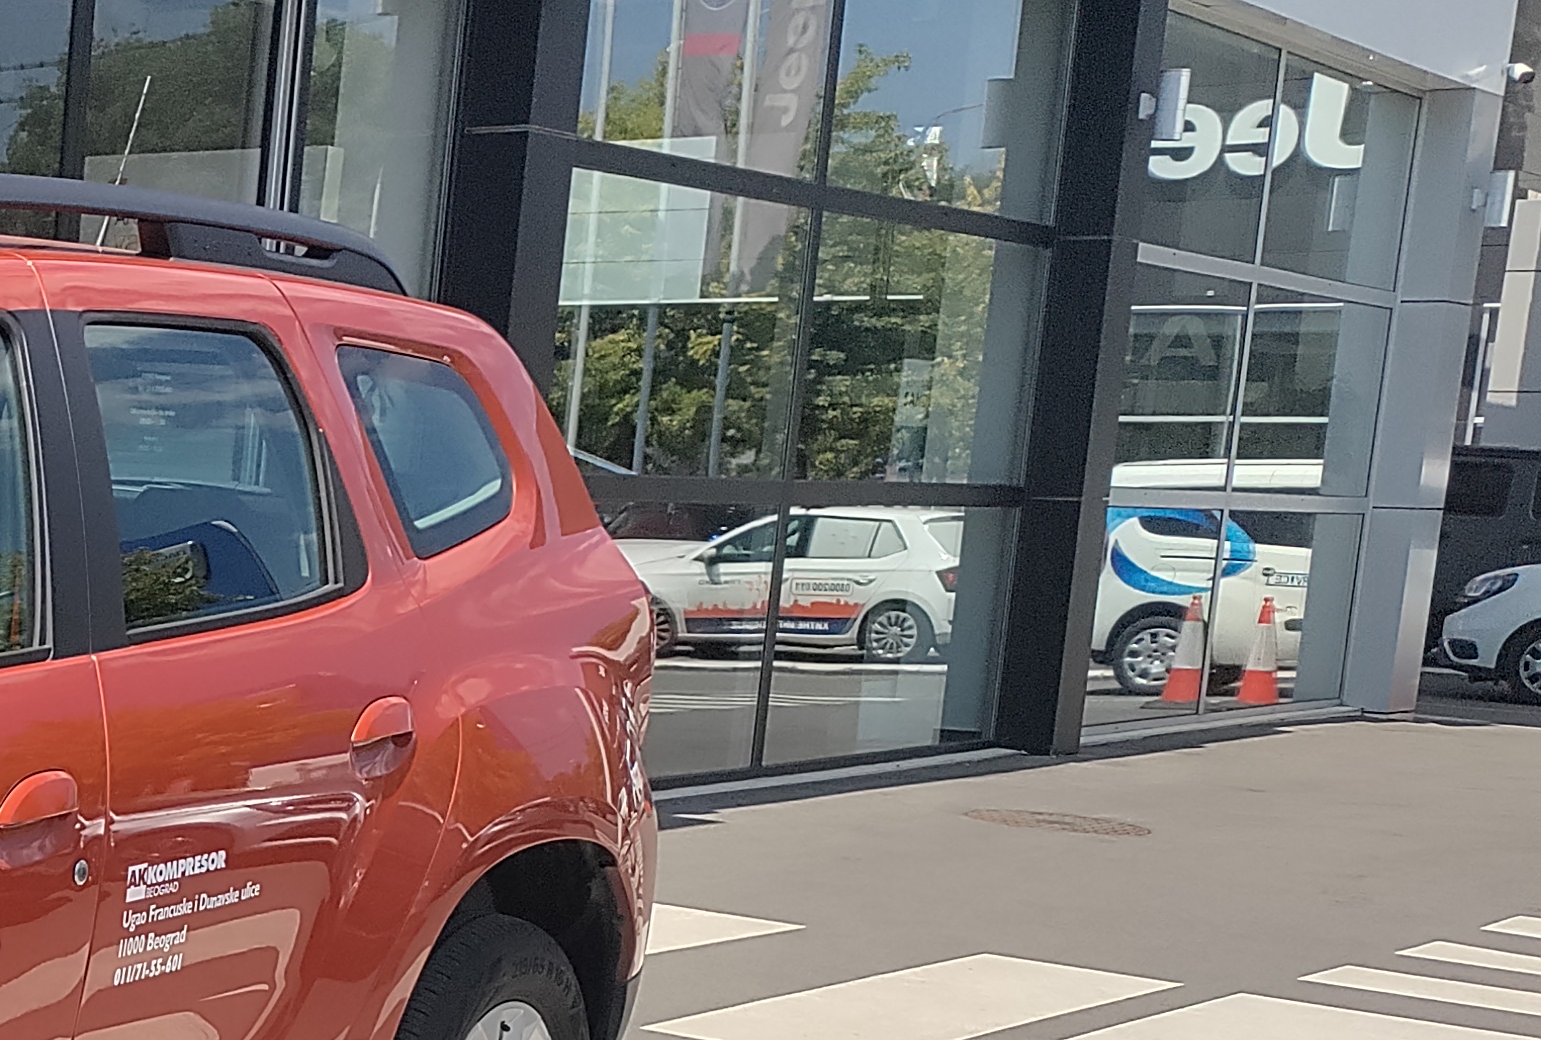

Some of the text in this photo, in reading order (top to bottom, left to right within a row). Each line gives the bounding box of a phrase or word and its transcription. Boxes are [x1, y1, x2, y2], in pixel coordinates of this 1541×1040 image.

[146, 850, 226, 885] KOMPRESOR
[145, 881, 179, 899] BEOGRAD
[122, 909, 147, 932] Ugao
[148, 898, 193, 923] Francuske
[194, 895, 199, 912] i
[199, 887, 239, 911] Dunavske
[118, 925, 188, 958] 11000 Beograd
[113, 953, 183, 986] 011/71-55-601
